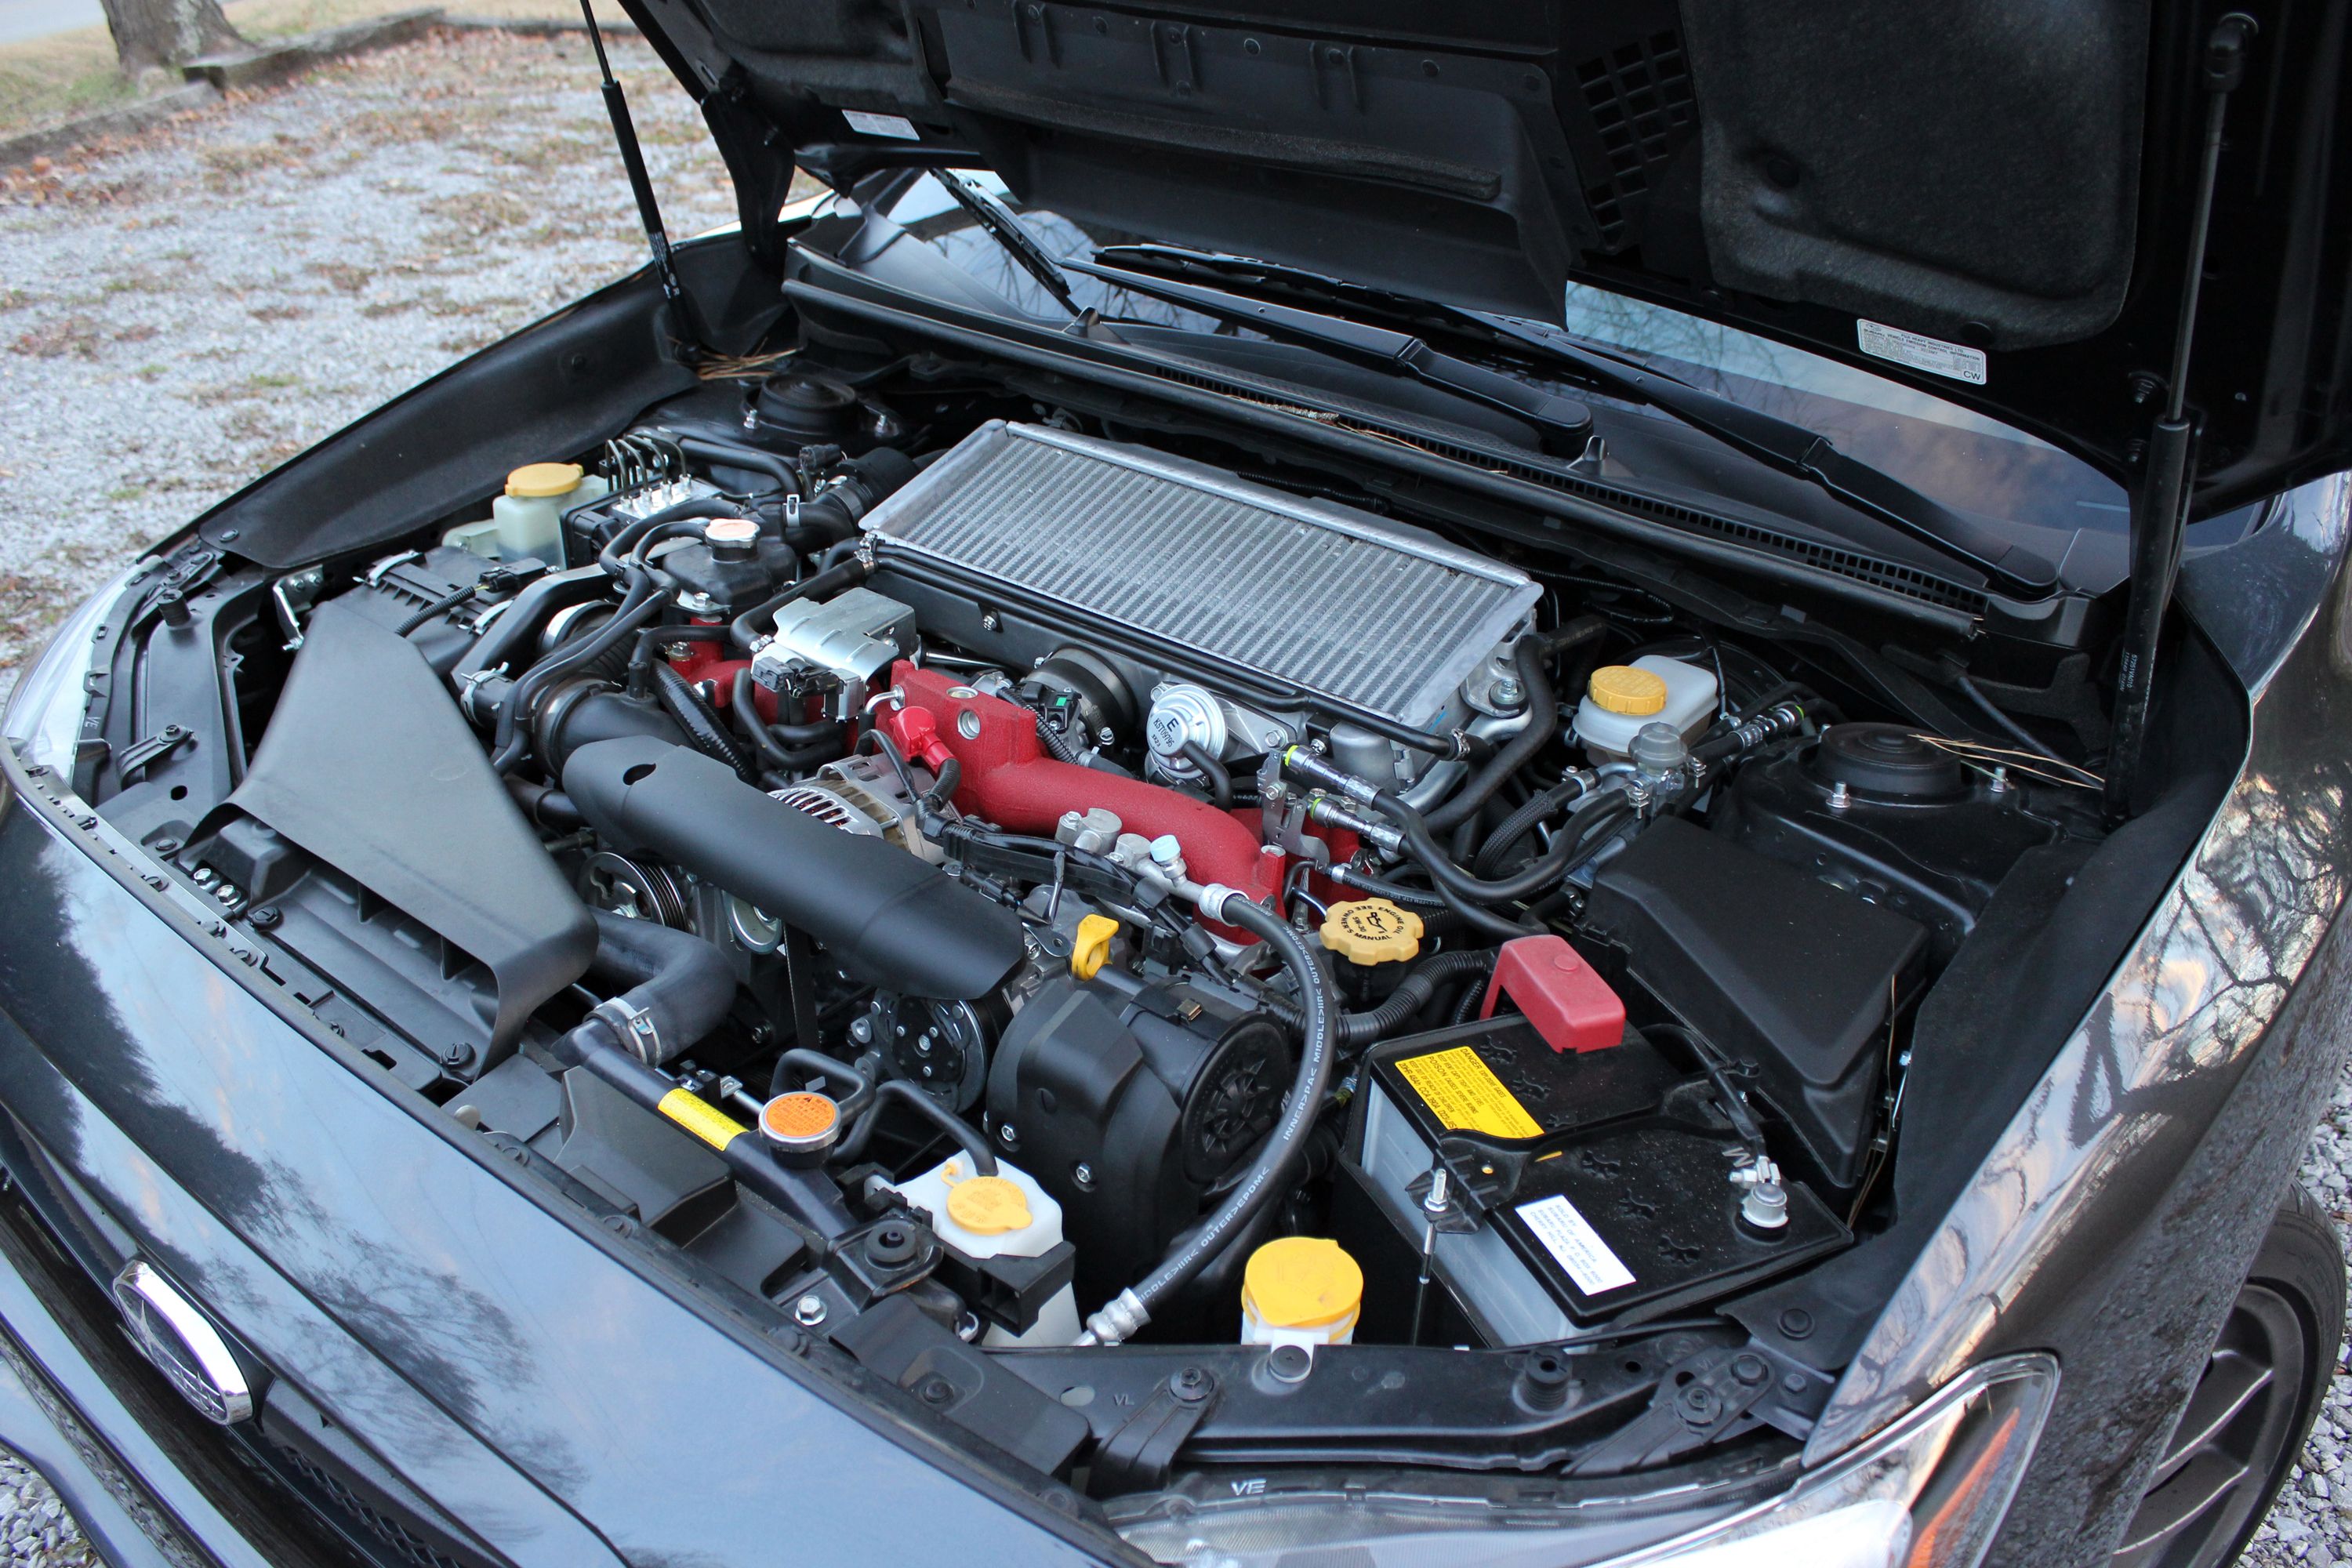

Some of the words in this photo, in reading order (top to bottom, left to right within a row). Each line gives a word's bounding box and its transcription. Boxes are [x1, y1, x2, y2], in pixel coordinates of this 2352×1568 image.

[1963, 370, 1981, 381] CW
[1167, 717, 1179, 732] E
[1352, 916, 1367, 932] 5W-30
[1378, 906, 1404, 925] ENGINE
[1393, 925, 1404, 935] OIL
[1354, 932, 1392, 941] MANUAL
[1428, 1056, 1448, 1076] POISON
[1461, 1048, 1482, 1069] DANGER
[1548, 1206, 1569, 1228] SUBARU
[1574, 1238, 1598, 1262] AMERICA
[1231, 1479, 1267, 1496] VE
